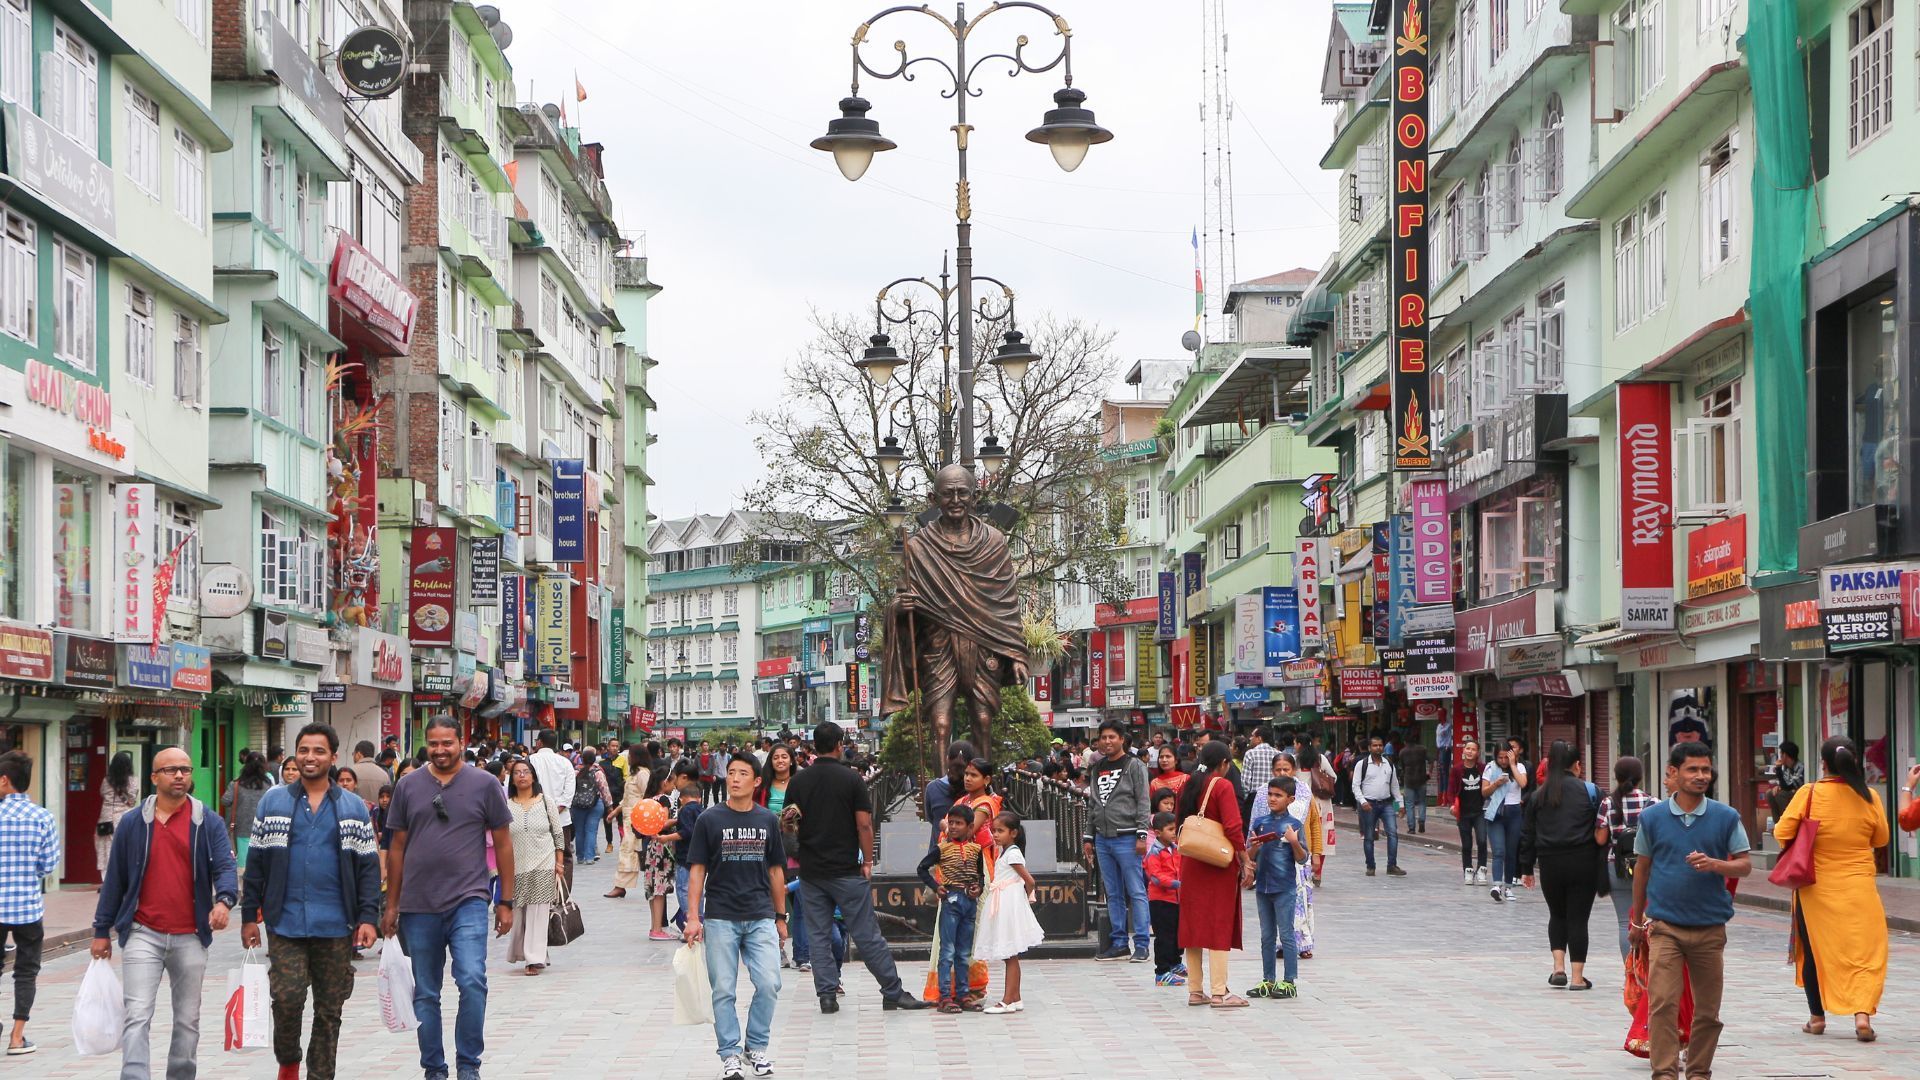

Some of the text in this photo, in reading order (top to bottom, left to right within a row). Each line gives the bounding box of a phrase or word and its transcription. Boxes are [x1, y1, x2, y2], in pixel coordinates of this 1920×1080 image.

[1398, 65, 1427, 374] BONFIRE
[1264, 296, 1282, 306] THE
[26, 358, 112, 432] CHAI CHUN
[1128, 440, 1153, 453] BANK
[1417, 483, 1444, 498] ALFA
[1624, 423, 1669, 547] Raymond
[554, 490, 582, 500] brothers'
[126, 487, 140, 550] CHAI
[558, 514, 575, 523] guest
[558, 537, 577, 547] house
[1420, 502, 1447, 596] LODGE
[482, 550, 496, 558] TICKET
[413, 578, 452, 590] Rajdhani
[1188, 572, 1197, 595] DZO
[1730, 571, 1741, 588] Sons
[1830, 569, 1904, 592] PAKSAM
[208, 587, 244, 597] AMUSEMENT
[436, 592, 452, 600] House
[505, 579, 514, 609] LAXMI
[1301, 542, 1319, 636] PARIVAR
[126, 567, 140, 631] CHUN
[1831, 594, 1873, 604] EXCLUSIVE
[1163, 590, 1172, 625] DZONG
[1628, 608, 1669, 621] SAMRAT
[1729, 602, 1741, 618] SONS
[548, 581, 562, 665] roll house
[1832, 614, 1847, 623] MIN.
[1847, 613, 1864, 622] PASS
[1865, 612, 1888, 621] PHOTO
[505, 613, 514, 649] SWEETS
[1240, 597, 1259, 671] firstcry
[1508, 619, 1525, 637] BANK
[1828, 622, 1889, 634] XEROX
[614, 627, 622, 677] WOODLAND
[1383, 651, 1405, 659] CHINA
[1407, 646, 1456, 656] FAMILY RESTAURANT
[1388, 660, 1405, 669] GIFT
[1427, 662, 1438, 670] BAR
[177, 671, 208, 687] AMUSEMENT
[1092, 664, 1100, 689] kotak
[1194, 649, 1206, 697] GOLDEN
[1343, 669, 1382, 679] MONEY
[1409, 675, 1454, 686] CHINA BAZAR
[1233, 691, 1262, 700] vivo
[1414, 684, 1450, 692] GIFTSHOP
[722, 827, 767, 840] MY ROAD TO
[888, 888, 906, 906] G.
